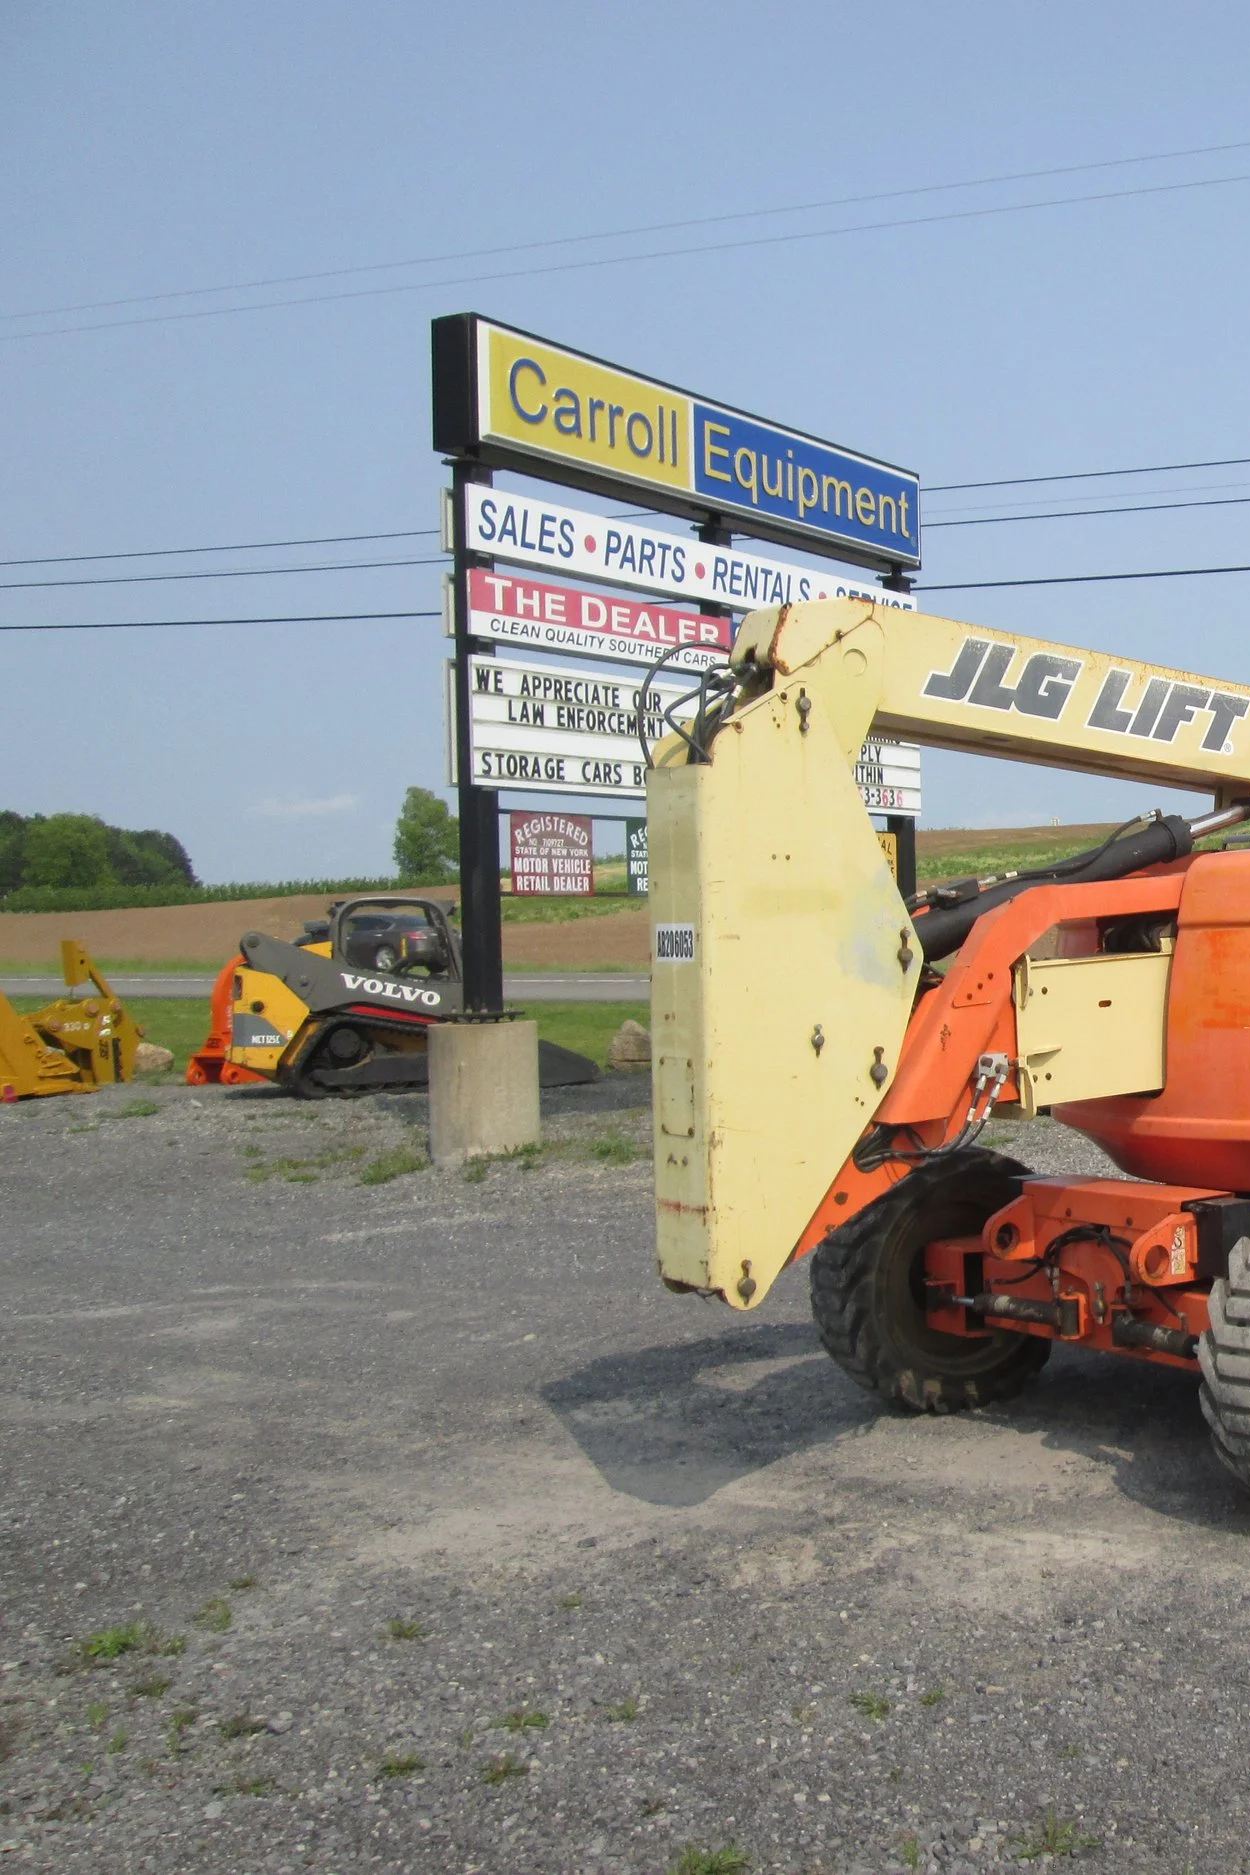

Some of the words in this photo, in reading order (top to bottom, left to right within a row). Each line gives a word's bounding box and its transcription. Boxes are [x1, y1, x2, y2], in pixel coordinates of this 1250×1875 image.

[508, 358, 678, 467] Carroll
[703, 420, 910, 538] Equipment
[478, 499, 575, 559] SALES
[604, 530, 686, 584] PARTS
[712, 556, 810, 604] RENTALS
[485, 576, 567, 622] THE
[581, 595, 719, 643] DEALER
[490, 618, 541, 639] CLEAN
[545, 628, 605, 649] QUALITY
[609, 638, 680, 661] SOUTHERN
[683, 651, 716, 667] CARS
[476, 668, 503, 693] WE
[520, 674, 620, 707] APPRECIATE
[632, 690, 661, 712] OUR
[921, 636, 1084, 722] JLG
[508, 699, 545, 726] LAW
[481, 752, 565, 780] STORAGE
[581, 761, 622, 785] CARS
[852, 764, 883, 784] ITHIN
[514, 815, 588, 845] REGISTERED
[514, 857, 548, 873] MOTOR
[552, 858, 591, 875] VEHICLE
[515, 846, 537, 855] STATE
[539, 847, 550, 856] OF
[551, 848, 568, 857] NEW
[569, 849, 589, 857] YORK
[516, 876, 550, 892] RETAIL
[553, 876, 590, 892] DEALER
[340, 972, 441, 1006] VOLVO
